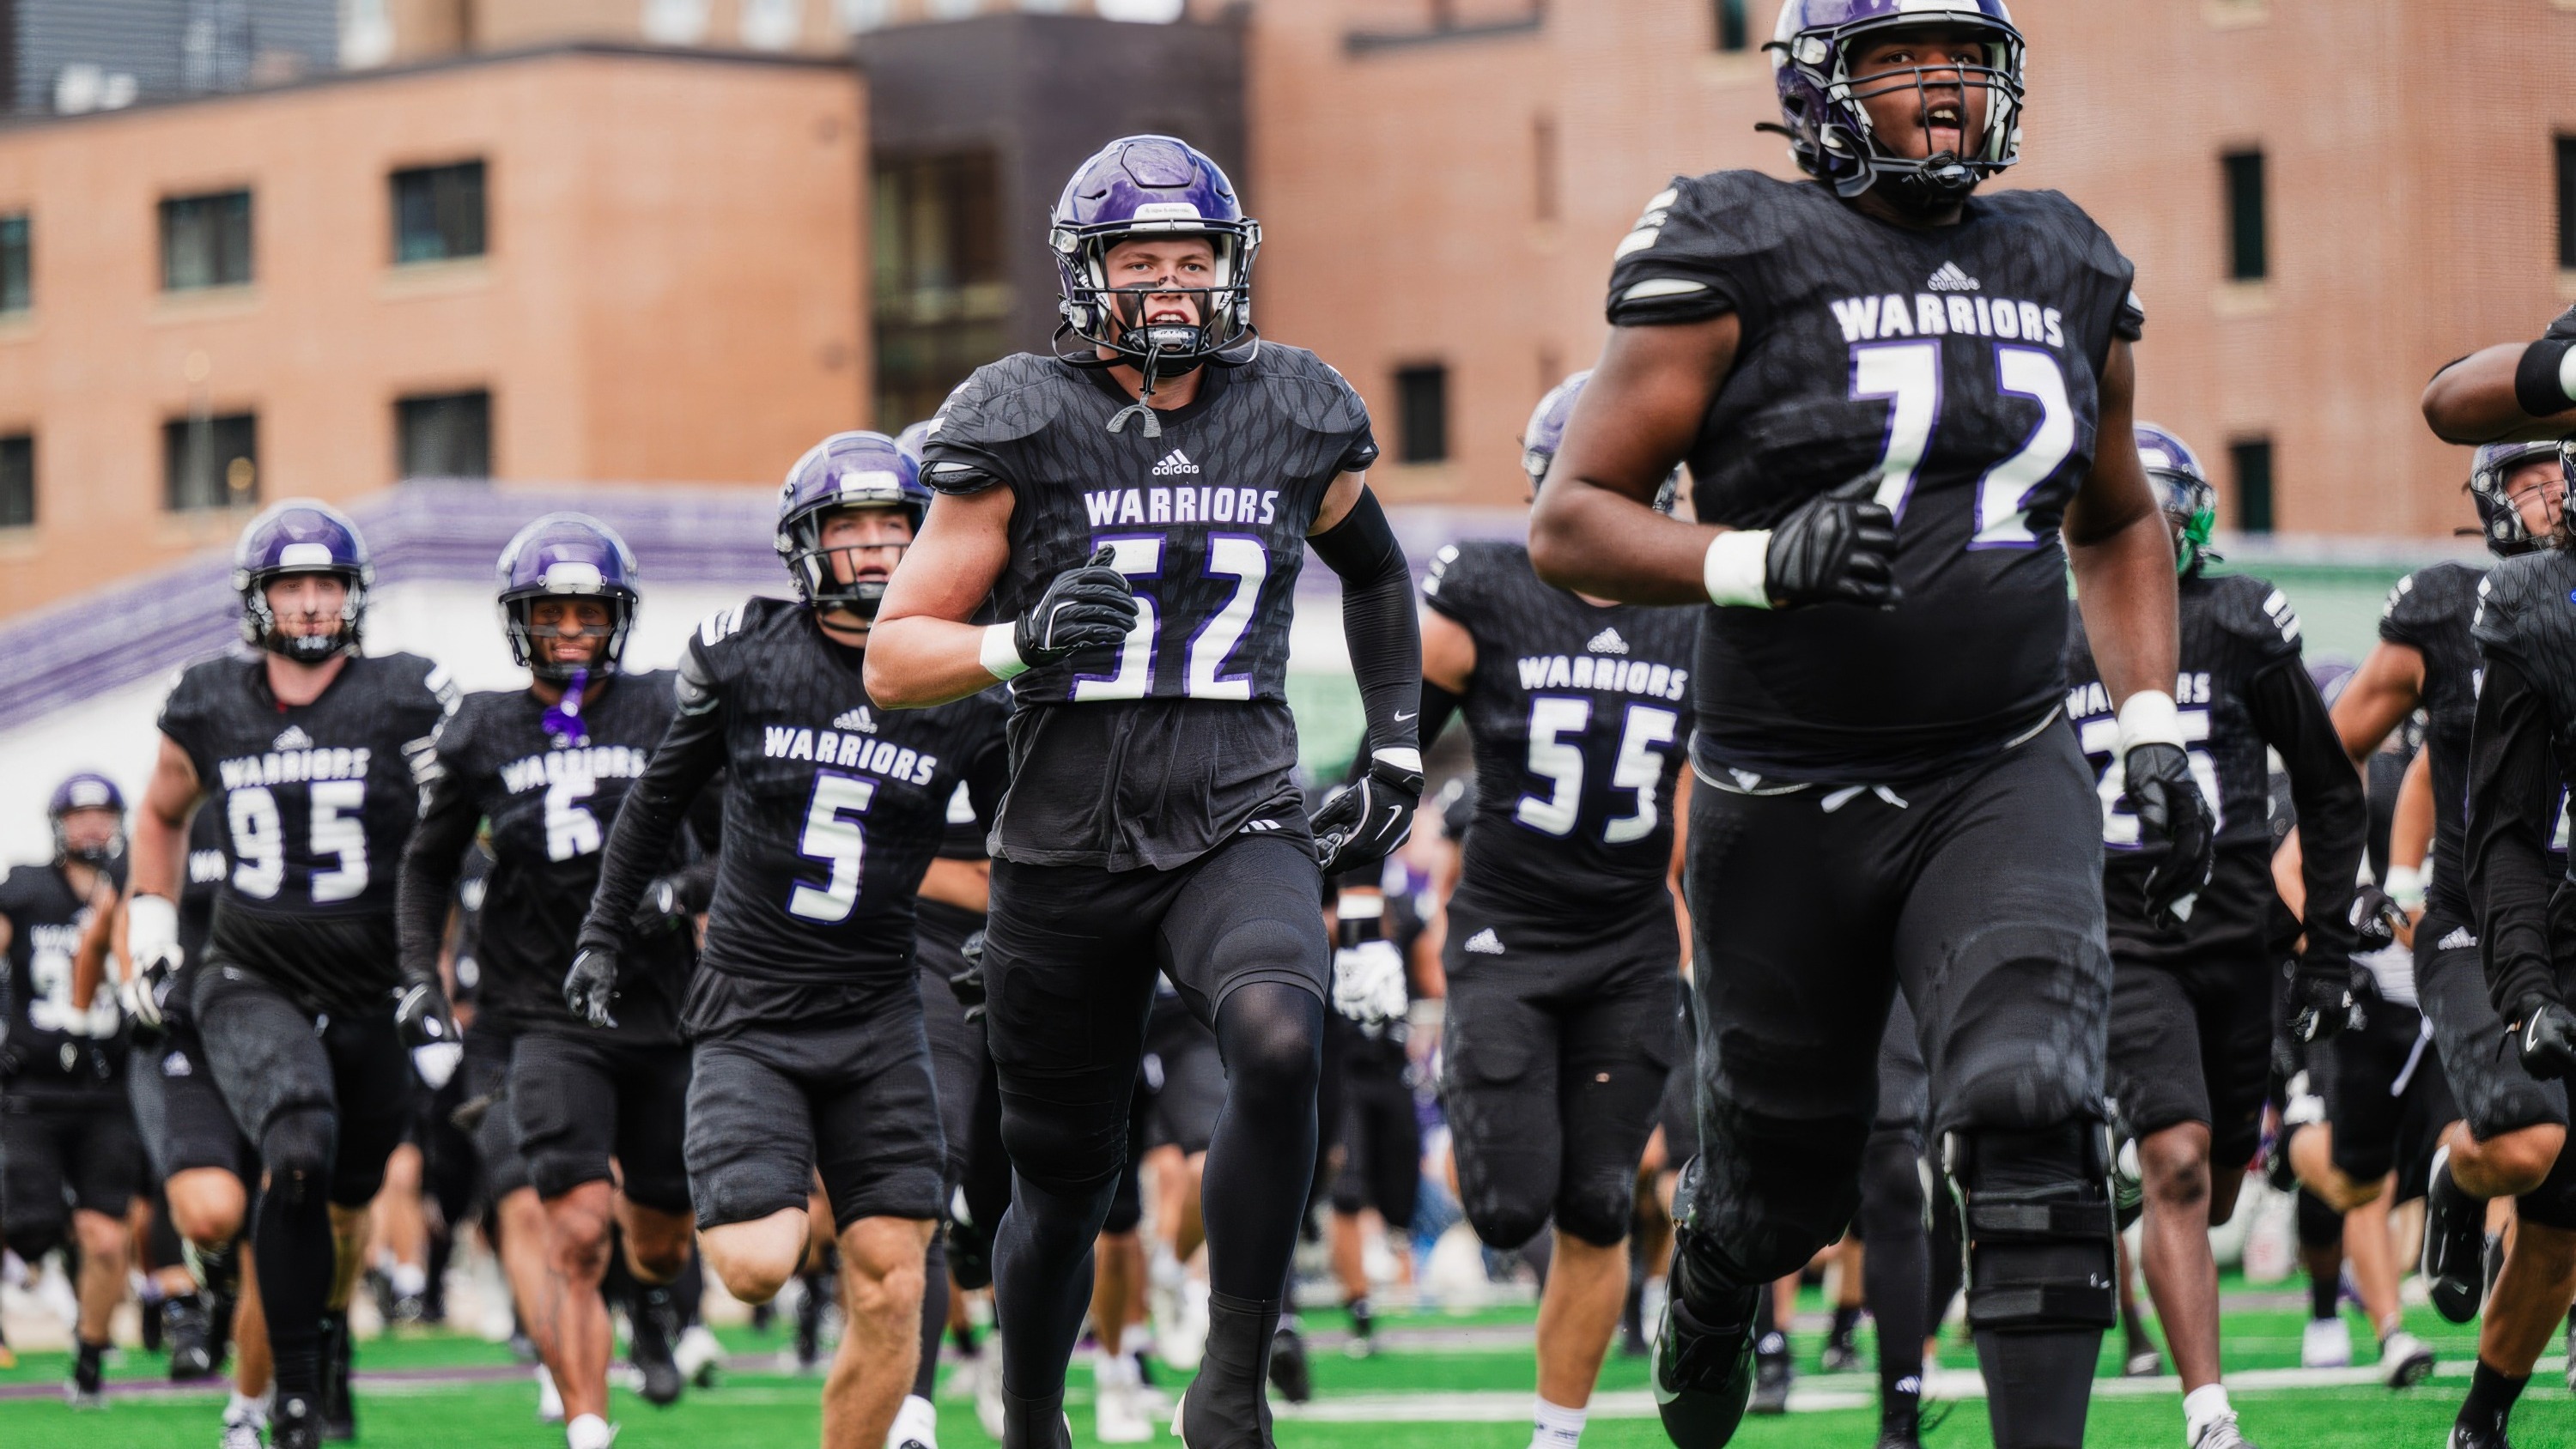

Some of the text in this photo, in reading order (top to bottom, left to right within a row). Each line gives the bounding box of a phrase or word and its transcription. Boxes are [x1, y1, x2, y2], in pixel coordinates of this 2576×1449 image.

[1830, 293, 2065, 349] WARRIORS
[1849, 338, 2079, 550] 72
[1084, 487, 1279, 526] WARRIORS
[1068, 531, 1273, 702] 52
[1517, 655, 1689, 701] WARRIORS
[220, 748, 372, 791] WARRIORS
[764, 726, 938, 786] WARRIORS
[1512, 693, 1680, 846] 55
[225, 779, 369, 905] 95
[786, 767, 881, 925] 5
